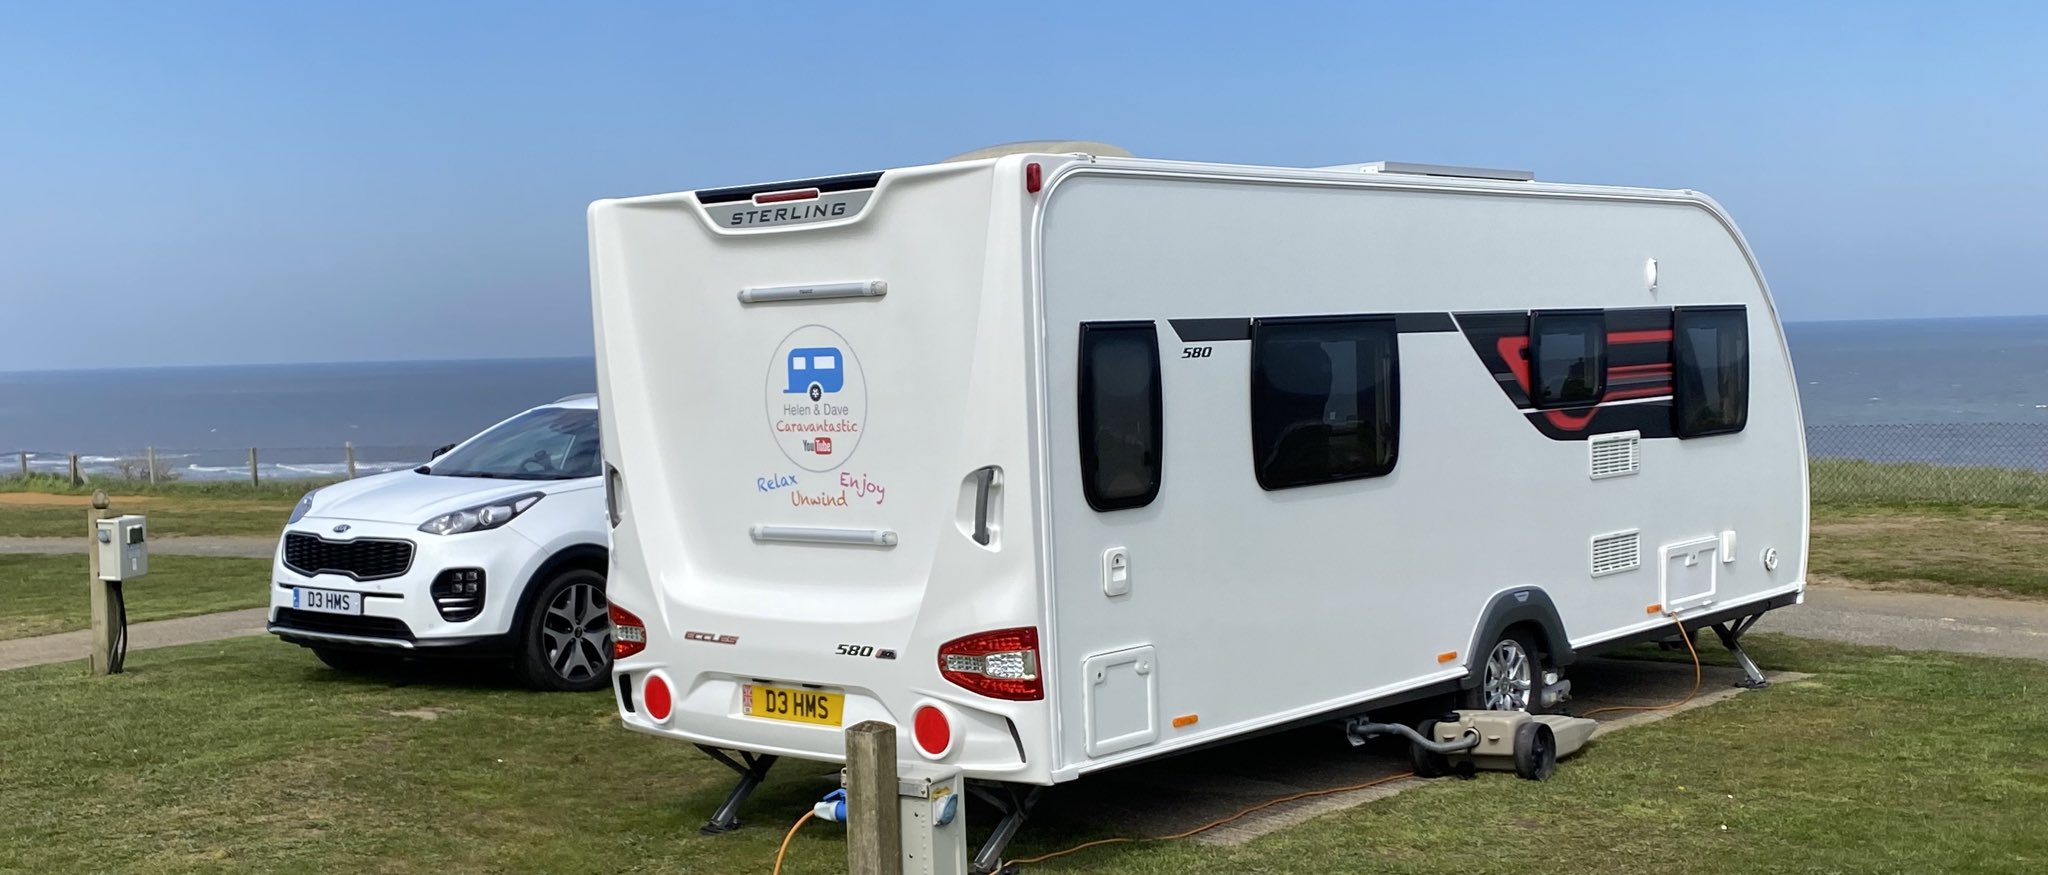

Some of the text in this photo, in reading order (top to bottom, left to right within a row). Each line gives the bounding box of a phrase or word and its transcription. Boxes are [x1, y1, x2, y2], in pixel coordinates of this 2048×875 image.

[731, 202, 847, 225] STERLING
[1181, 346, 1213, 359] 580
[783, 403, 849, 416] Helen & Dave
[776, 419, 858, 432] Caravantastic
[803, 438, 832, 453] YouTube
[757, 473, 798, 492] Relax
[840, 471, 885, 505] Enjoy
[791, 490, 848, 507] Unwind
[307, 591, 350, 611] D3 HMS
[684, 631, 740, 645] ECCLES
[835, 643, 874, 657] 580
[765, 689, 829, 719] D3 HMS
